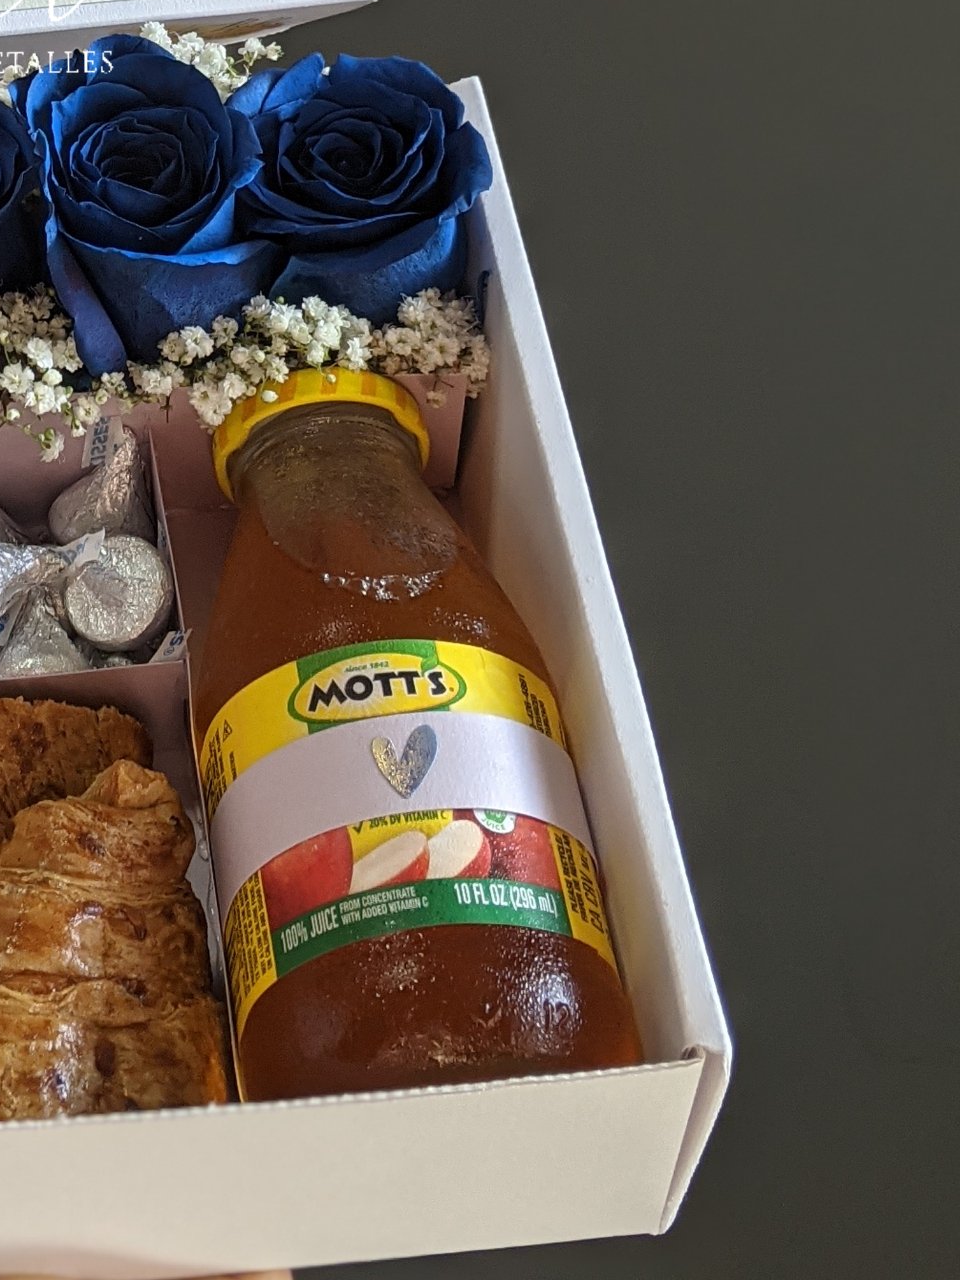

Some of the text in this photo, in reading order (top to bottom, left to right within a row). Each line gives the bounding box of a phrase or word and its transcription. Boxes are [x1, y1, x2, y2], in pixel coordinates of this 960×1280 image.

[307, 670, 447, 713] MOTT'S
[339, 885, 417, 914] FROM CONCENTRATE
[340, 895, 429, 926] WITH ADDED VITAMIN C
[453, 882, 559, 919] 10 FL OZ (296 mL)
[280, 906, 340, 954] 100% JUICE
